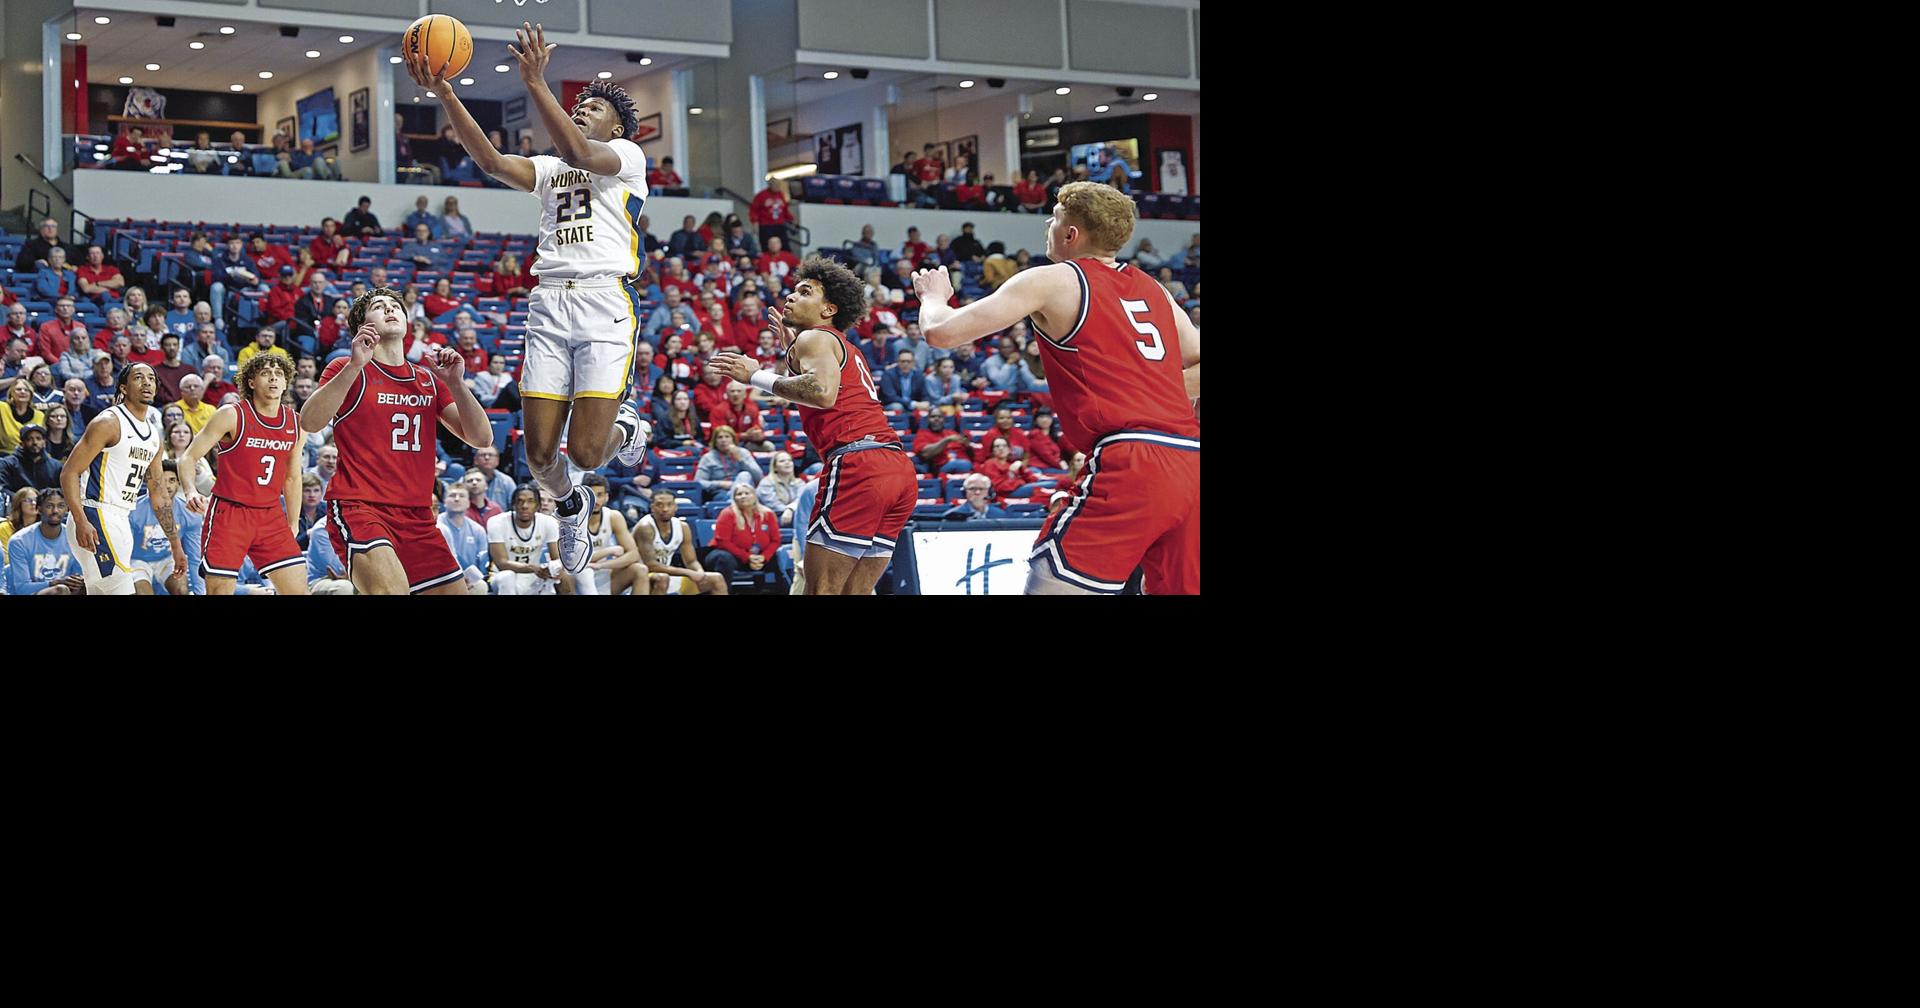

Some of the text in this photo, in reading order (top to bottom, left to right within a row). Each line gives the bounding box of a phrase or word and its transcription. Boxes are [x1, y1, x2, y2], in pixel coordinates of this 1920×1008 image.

[411, 23, 422, 54] NCAA
[556, 188, 592, 224] 23
[556, 225, 594, 246] STATE
[1118, 296, 1167, 361] 5
[377, 392, 433, 407] BELMONT
[245, 437, 294, 451] BELMONT
[391, 412, 422, 452] 21
[256, 454, 277, 486] 3
